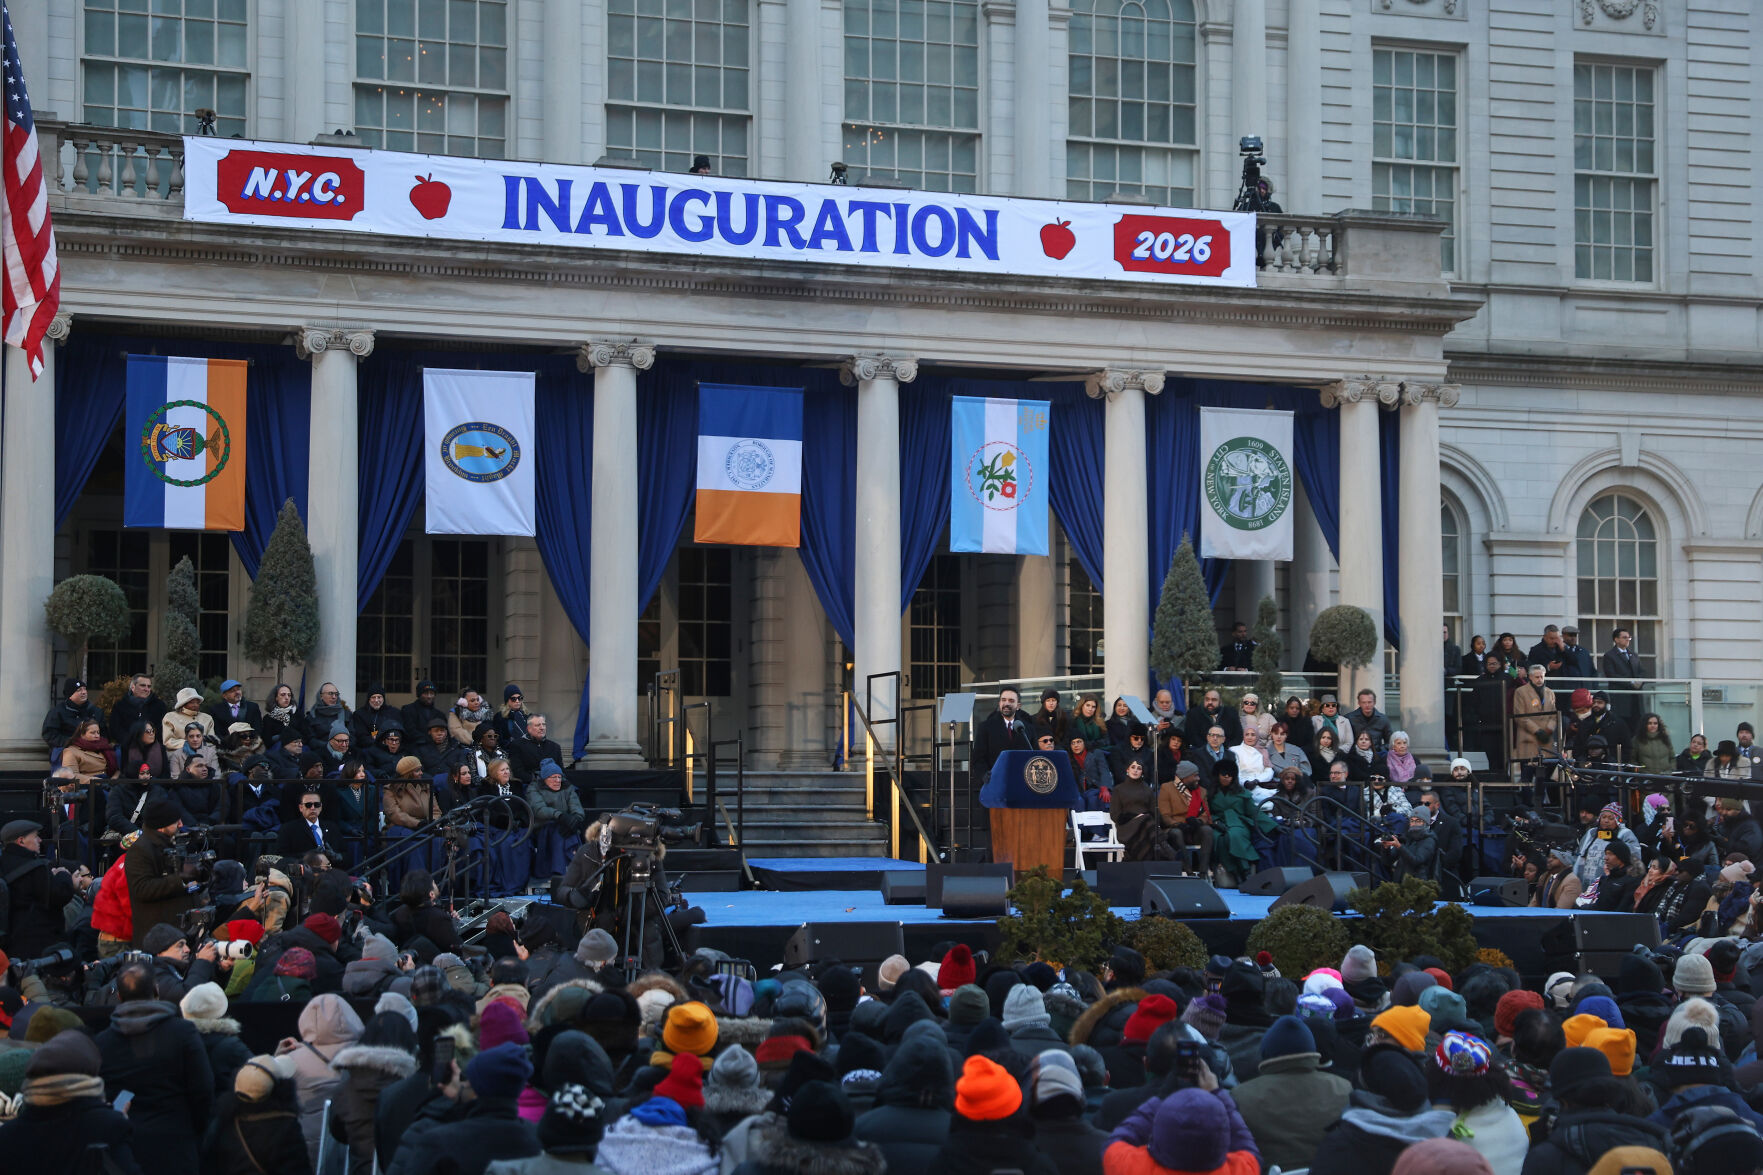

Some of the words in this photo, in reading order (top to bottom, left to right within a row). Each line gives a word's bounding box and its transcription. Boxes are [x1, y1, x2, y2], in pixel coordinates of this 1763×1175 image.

[240, 166, 345, 206] N.Y.C.
[502, 175, 1000, 261] INAUGURATION
[1130, 230, 1213, 265] 2026
[1213, 445, 1229, 462] CITY
[1248, 439, 1264, 449] 1699
[1206, 472, 1215, 494] NEW
[1269, 449, 1289, 485] STATEN
[1210, 496, 1229, 521] YORK
[1268, 488, 1290, 521] ISLAND
